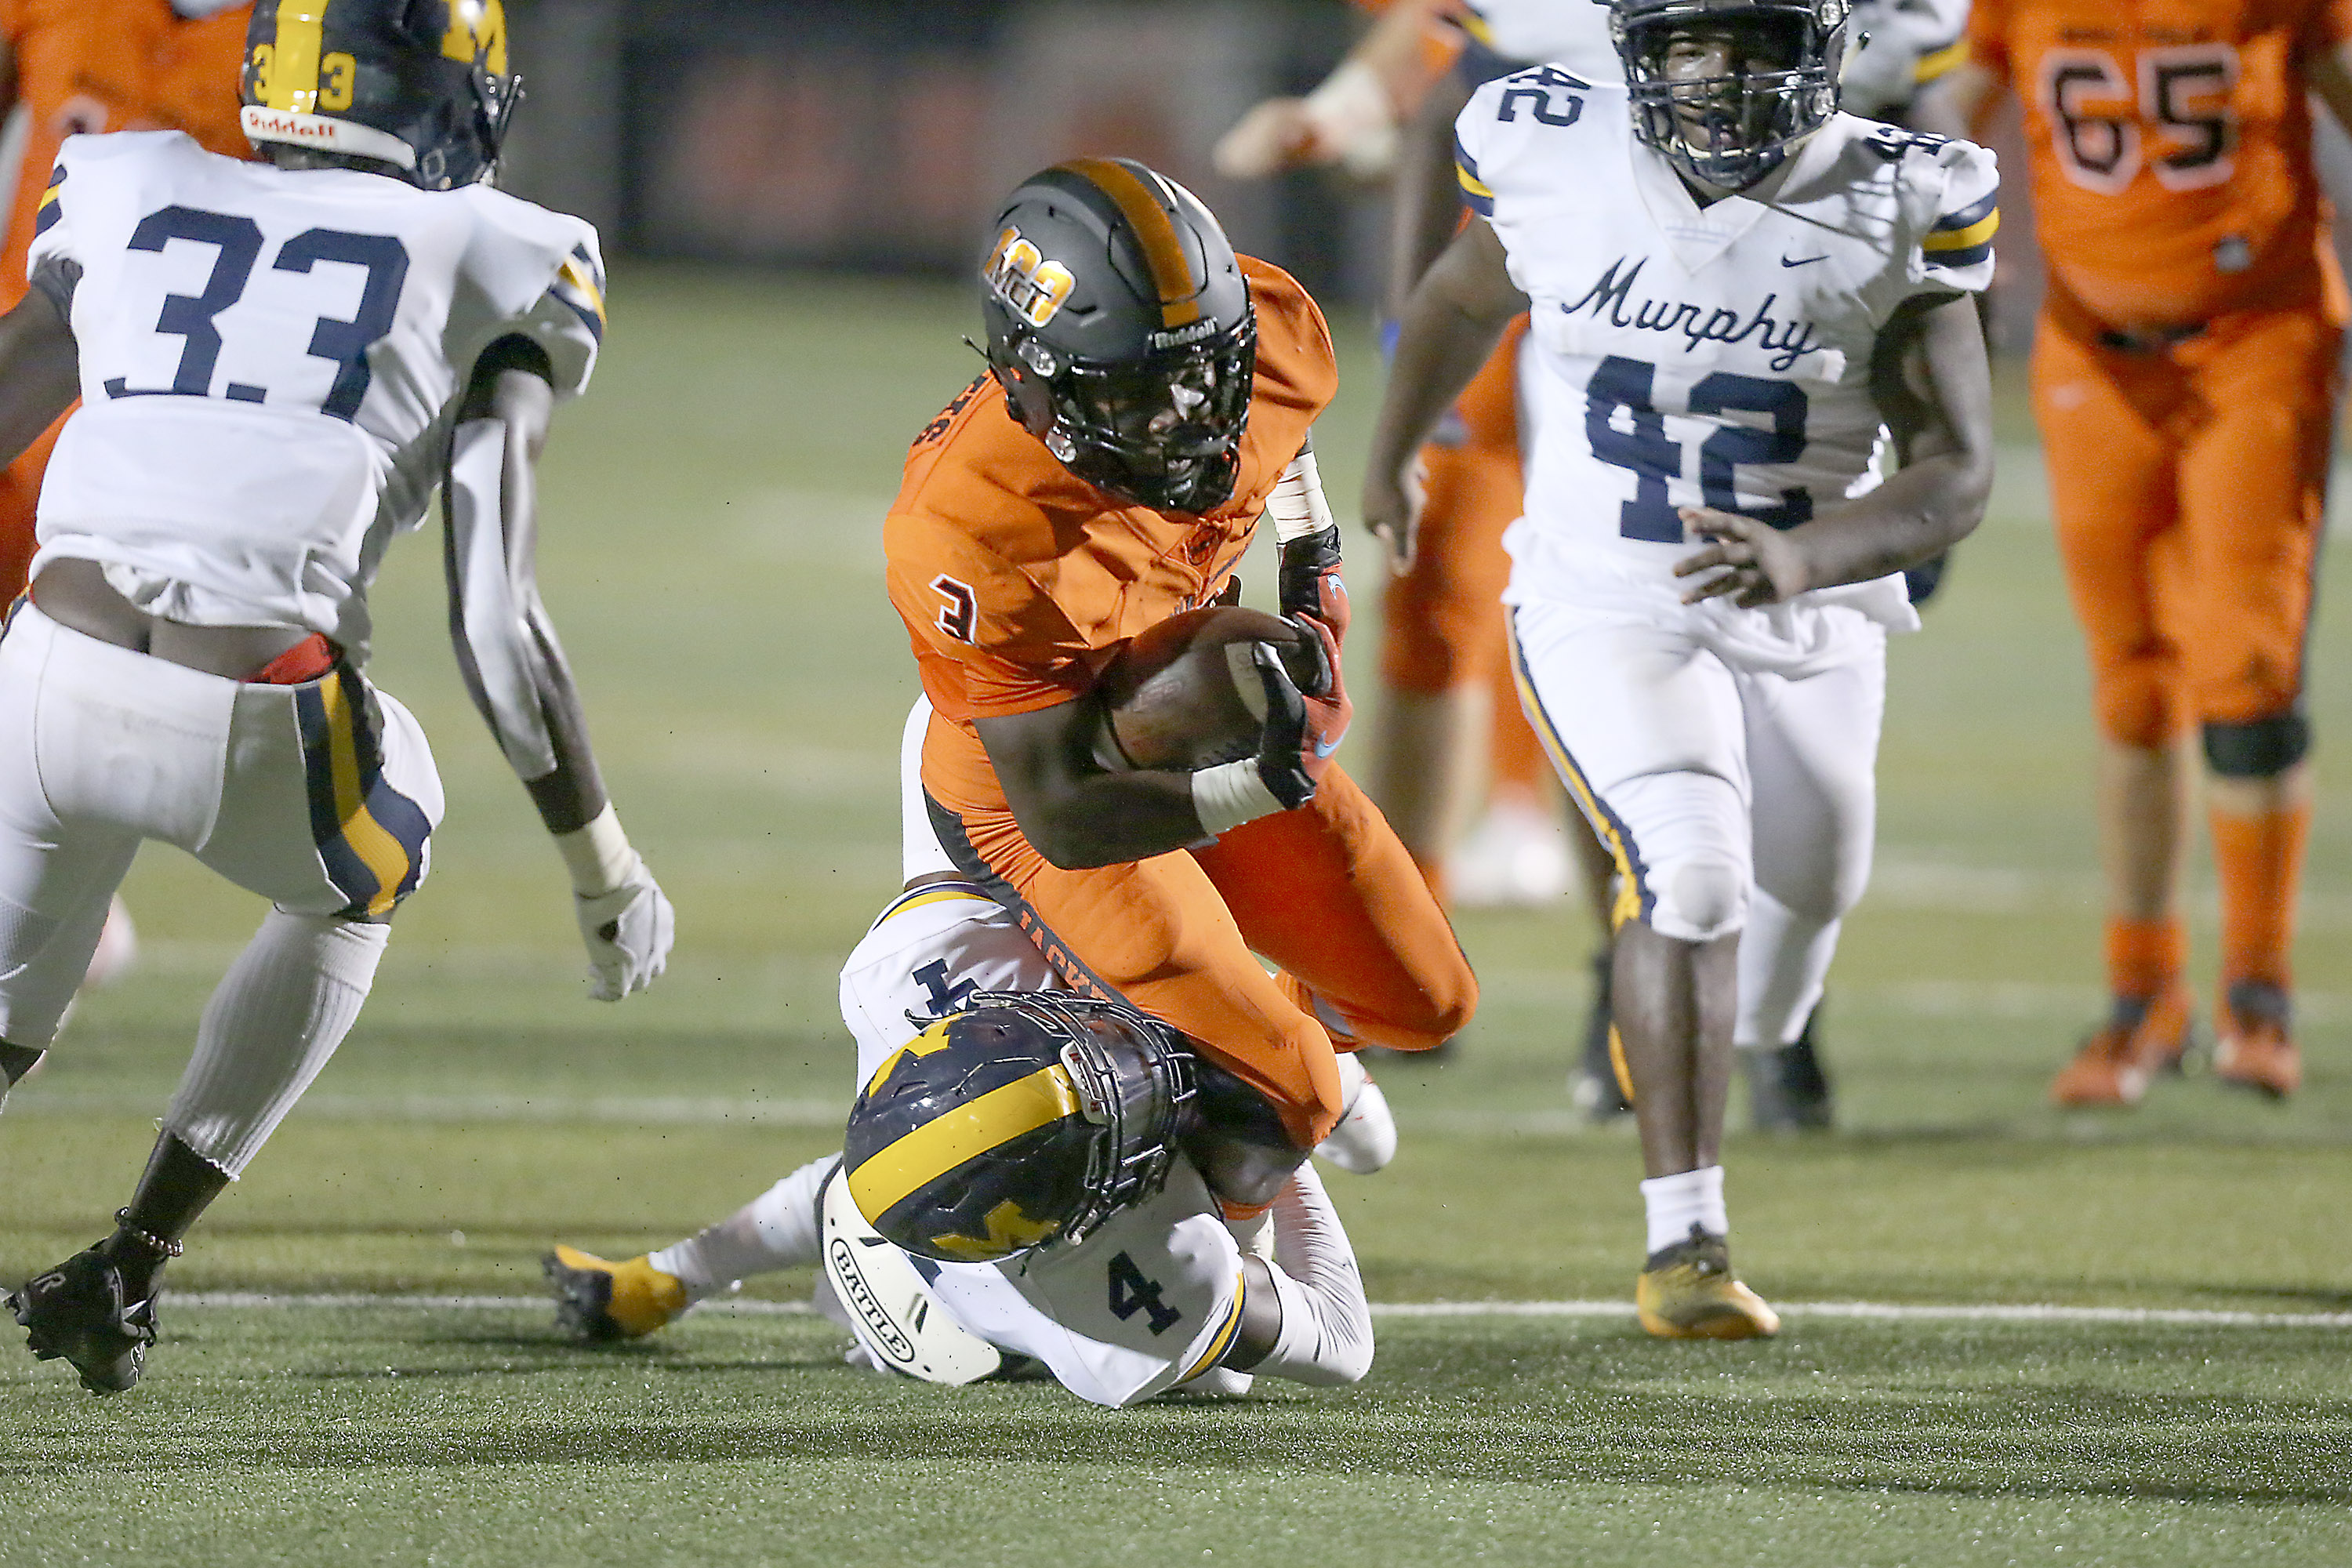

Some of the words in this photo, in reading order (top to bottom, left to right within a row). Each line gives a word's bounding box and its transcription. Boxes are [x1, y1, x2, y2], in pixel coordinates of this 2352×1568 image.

[2036, 43, 2241, 195] 65
[103, 205, 410, 423] 33
[1560, 254, 1824, 372] Murphy
[1585, 354, 1813, 543] 42
[837, 1249, 907, 1353] BATTLE
[1109, 1250, 1181, 1337] 4
